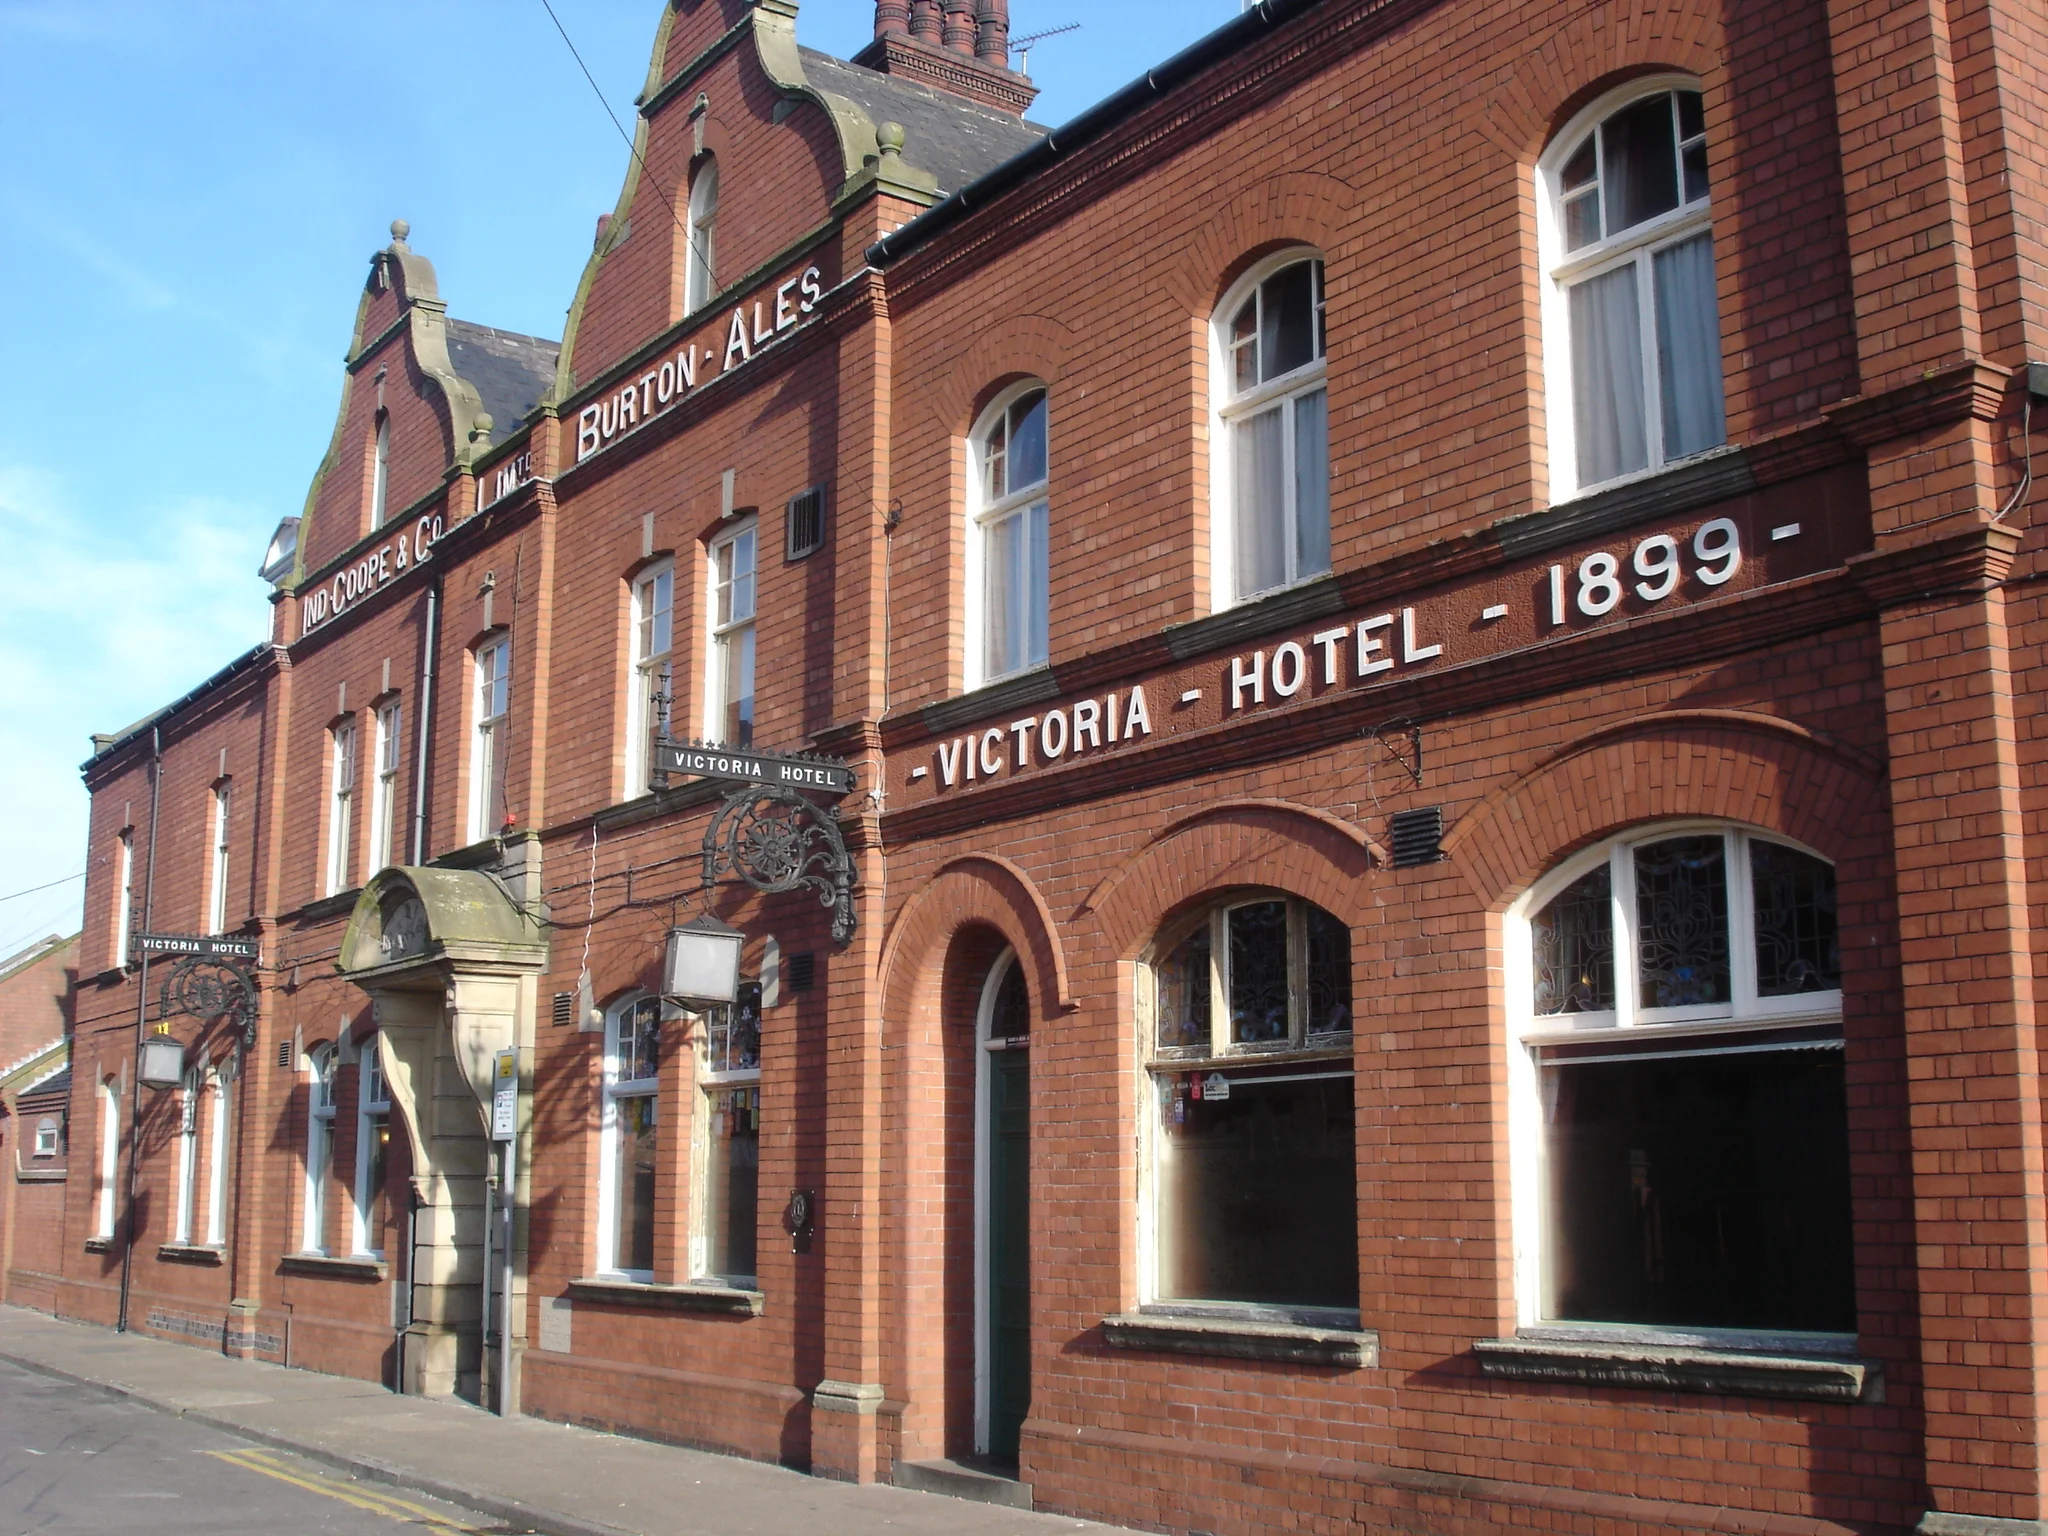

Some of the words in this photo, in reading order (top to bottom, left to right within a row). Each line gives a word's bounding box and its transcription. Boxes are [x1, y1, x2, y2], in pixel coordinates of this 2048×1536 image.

[578, 343, 697, 462] BURTON
[723, 266, 821, 371] ALES
[331, 545, 391, 614] COOPE
[397, 535, 406, 568] &
[939, 685, 1151, 786] VICTORIA
[1231, 607, 1443, 709] HOTEL
[1550, 517, 1742, 626] 1899
[675, 752, 762, 777] VICTORIA
[781, 765, 836, 786] HOTEL
[143, 939, 200, 951] VICTORIA
[211, 943, 249, 954] HOTEL
